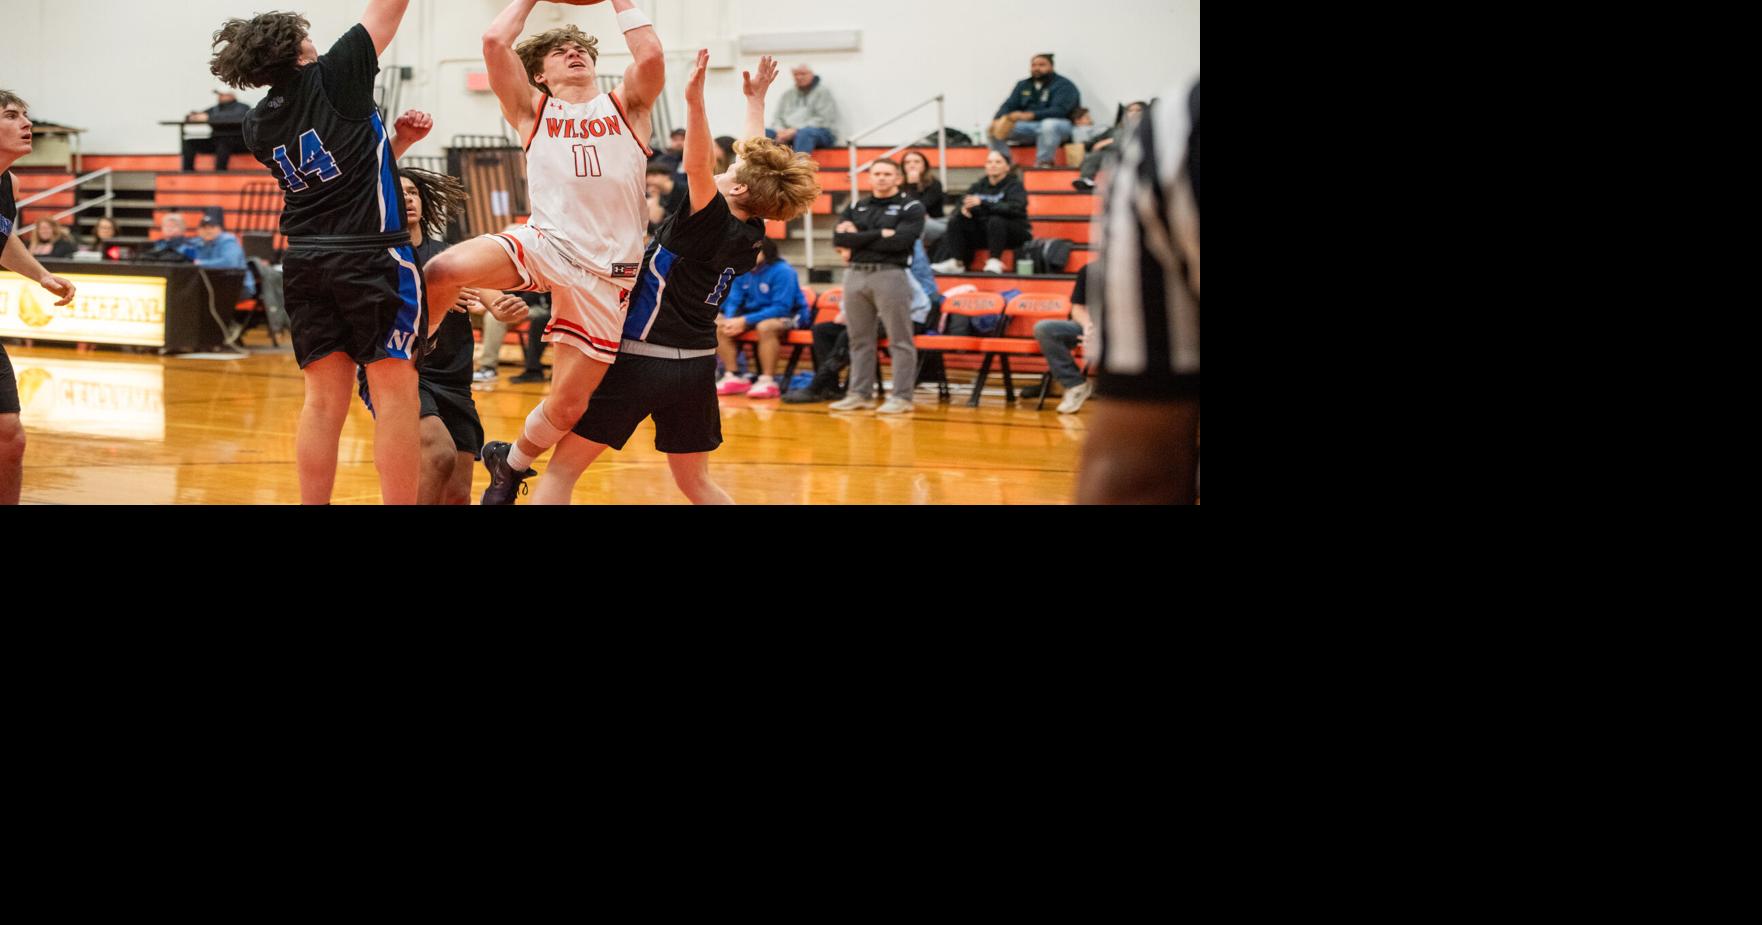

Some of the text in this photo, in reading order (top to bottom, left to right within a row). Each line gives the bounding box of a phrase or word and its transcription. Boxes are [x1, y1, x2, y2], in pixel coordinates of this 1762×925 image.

[546, 115, 621, 139] WILSON
[272, 128, 342, 192] 14
[572, 144, 601, 177] 11
